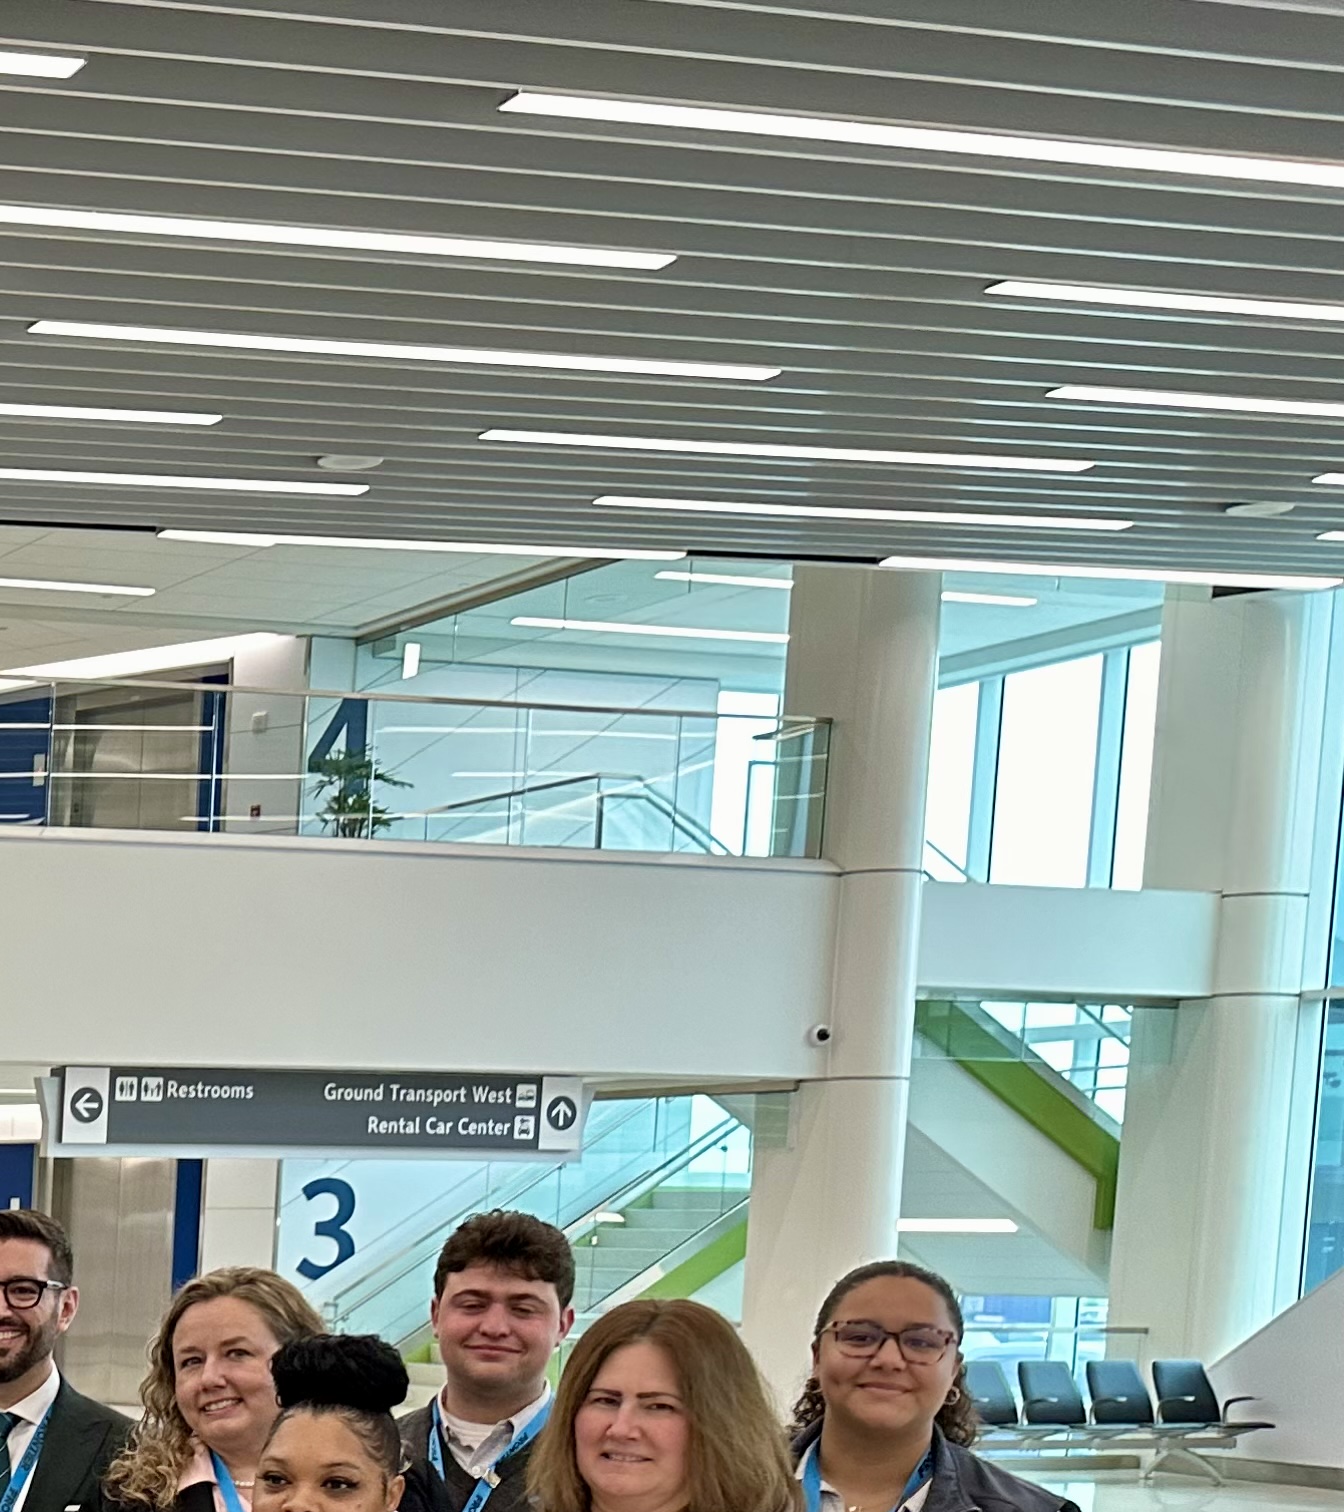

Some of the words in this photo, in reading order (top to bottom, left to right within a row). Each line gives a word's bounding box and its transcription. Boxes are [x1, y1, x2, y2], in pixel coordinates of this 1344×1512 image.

[308, 698, 369, 797] 4
[167, 1080, 254, 1099] Restrooms
[324, 1082, 384, 1101] Ground
[390, 1084, 467, 1107] Transport
[472, 1086, 512, 1104] West
[367, 1116, 420, 1134] Rental
[425, 1117, 453, 1134] Car
[457, 1118, 510, 1136] Center
[296, 1177, 356, 1280] 3
